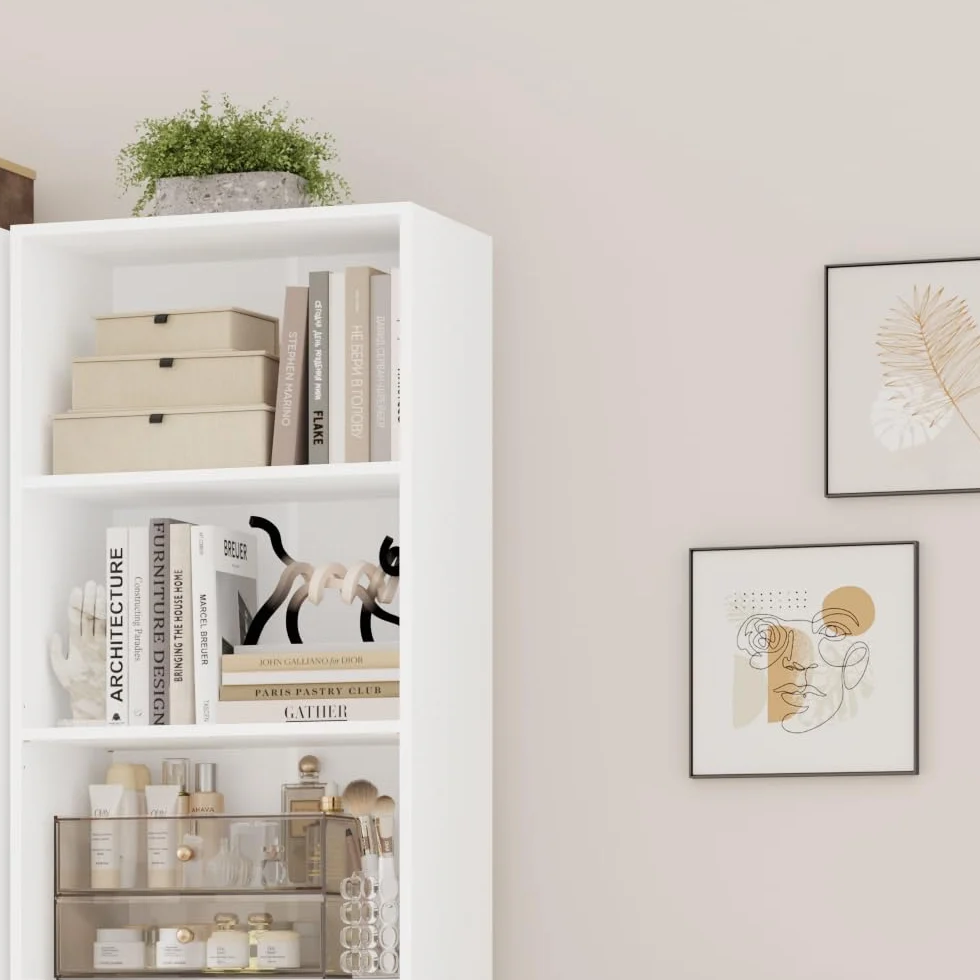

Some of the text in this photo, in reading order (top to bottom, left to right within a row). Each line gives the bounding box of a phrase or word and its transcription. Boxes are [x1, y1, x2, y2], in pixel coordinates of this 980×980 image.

[350, 325, 364, 343] НЕ
[350, 344, 364, 376] БЕРИ
[281, 331, 298, 427] STEPHEN MARINO
[350, 379, 364, 387] В
[312, 410, 324, 446] FLAKE
[350, 390, 364, 438] ГОЛОВУ
[224, 539, 248, 560] BREUER
[132, 576, 143, 626] Constructing
[110, 548, 123, 702] ARCHITECTURE
[153, 522, 165, 726] FURNITURE DESIGN
[174, 569, 183, 682] BRINGING THE HOUSE HOME
[200, 631, 208, 665] BREUER
[259, 659, 282, 667] JOHN
[284, 658, 328, 667] GALLIANO
[341, 657, 363, 665] DIOR
[255, 686, 382, 697] PARIS PASTRY CLUB
[284, 704, 348, 719] GATHER
